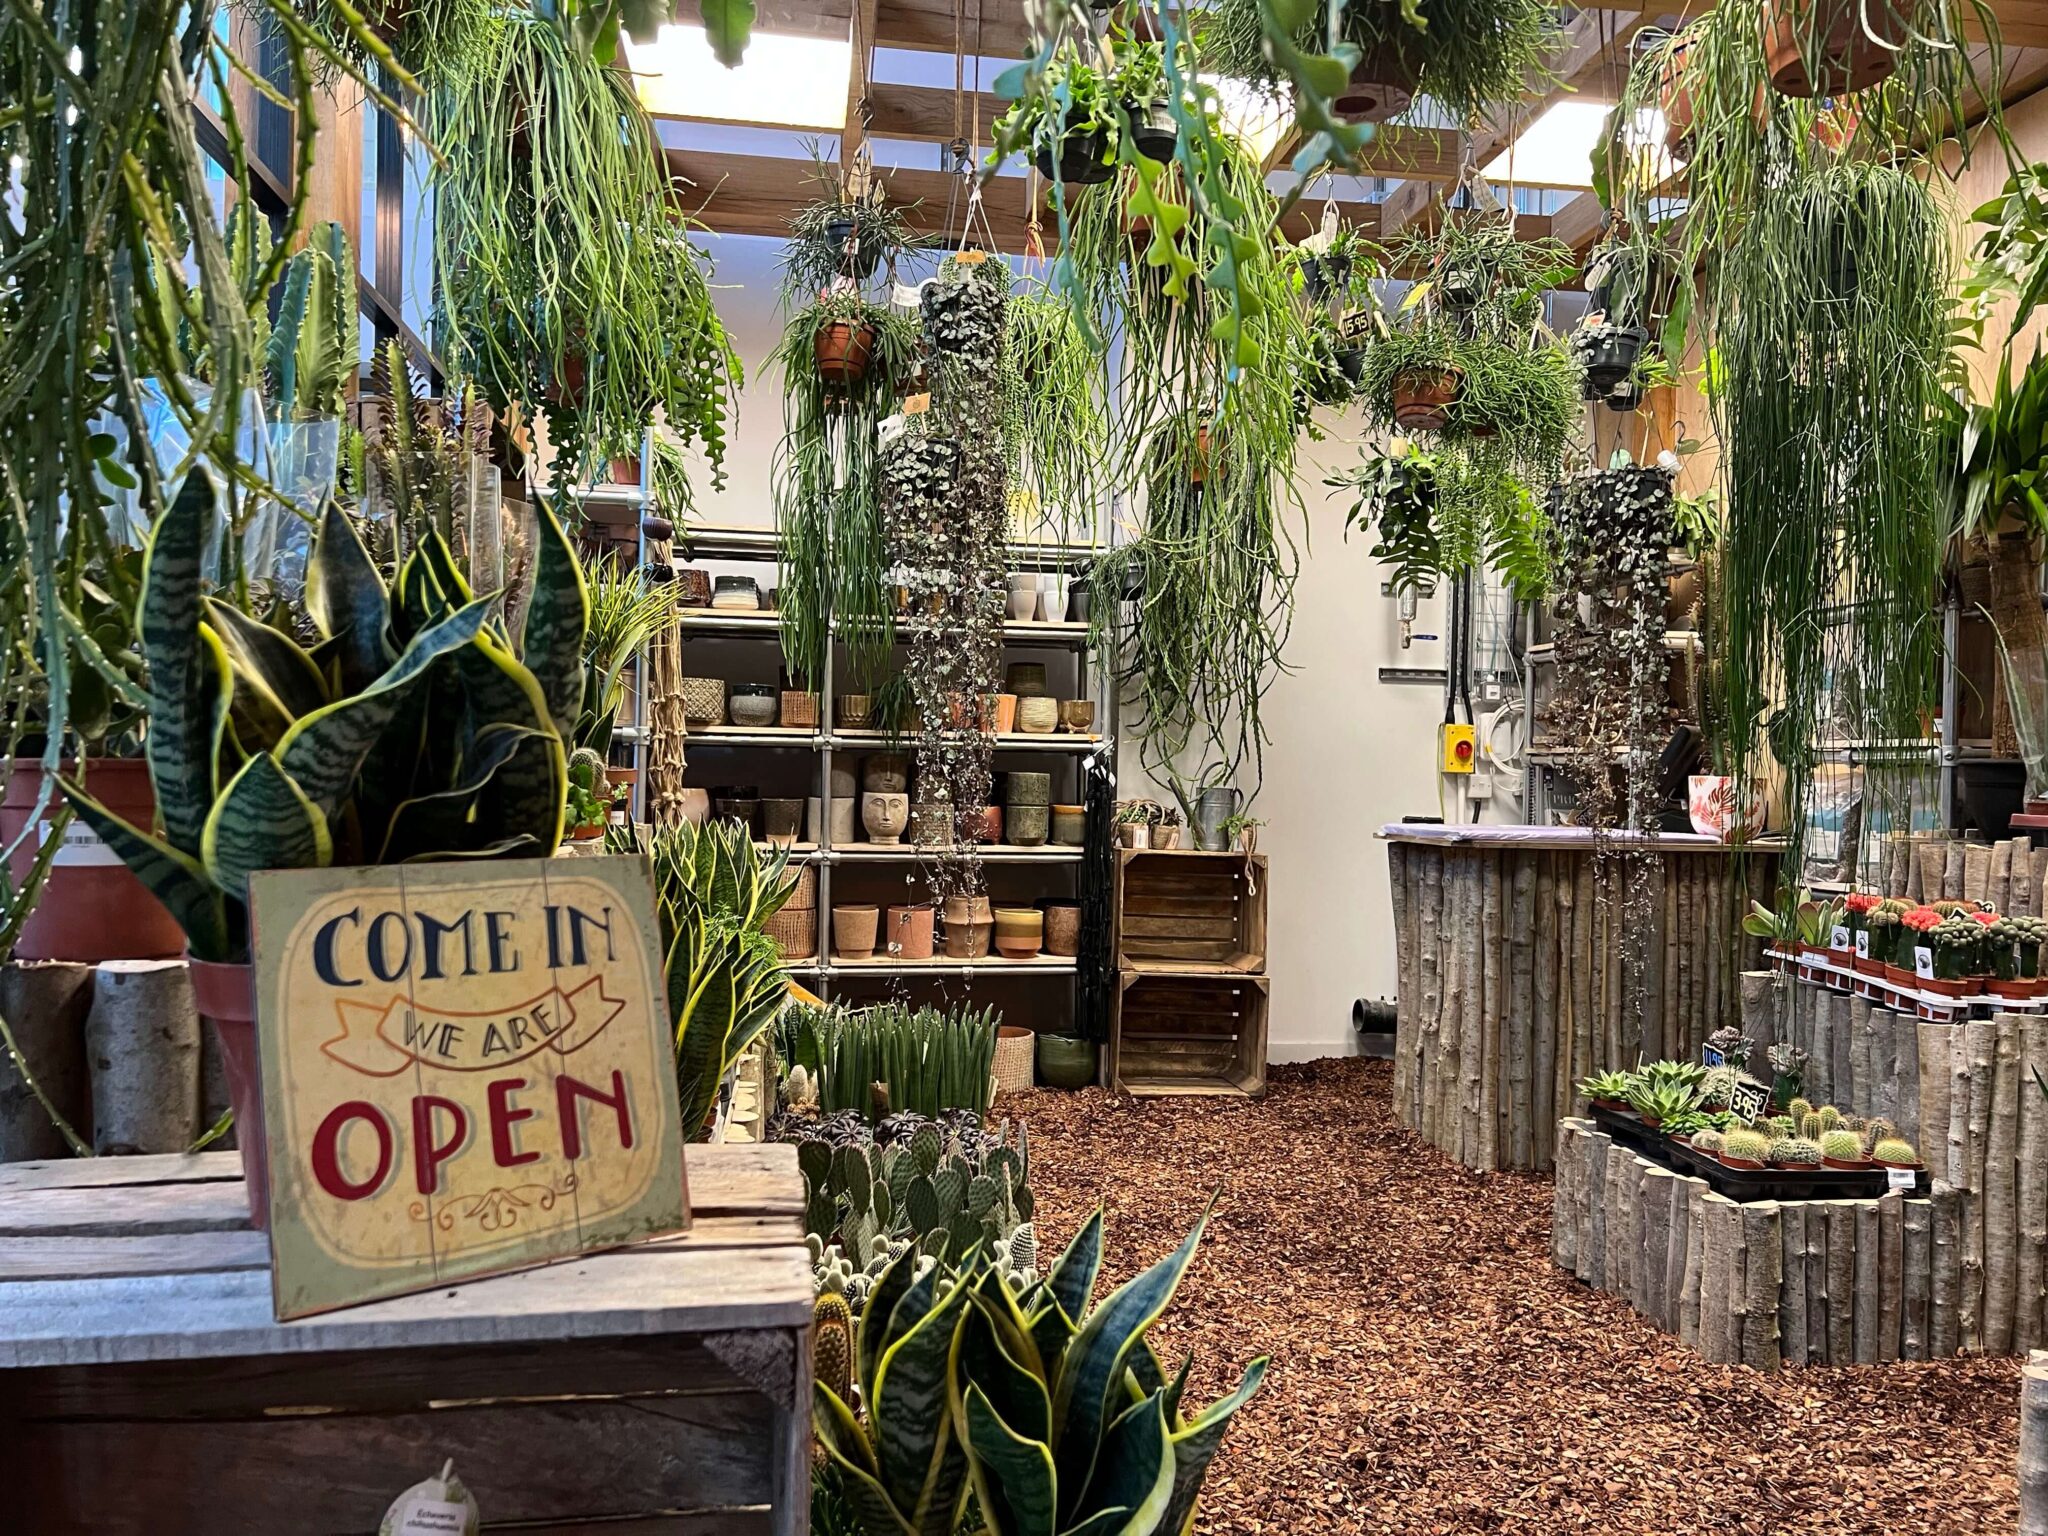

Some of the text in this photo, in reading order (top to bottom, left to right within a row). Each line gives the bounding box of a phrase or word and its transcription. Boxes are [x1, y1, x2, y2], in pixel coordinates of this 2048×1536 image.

[312, 906, 616, 986] COME IN
[404, 1003, 560, 1059] WE ARE
[311, 1069, 634, 1200] OPEN
